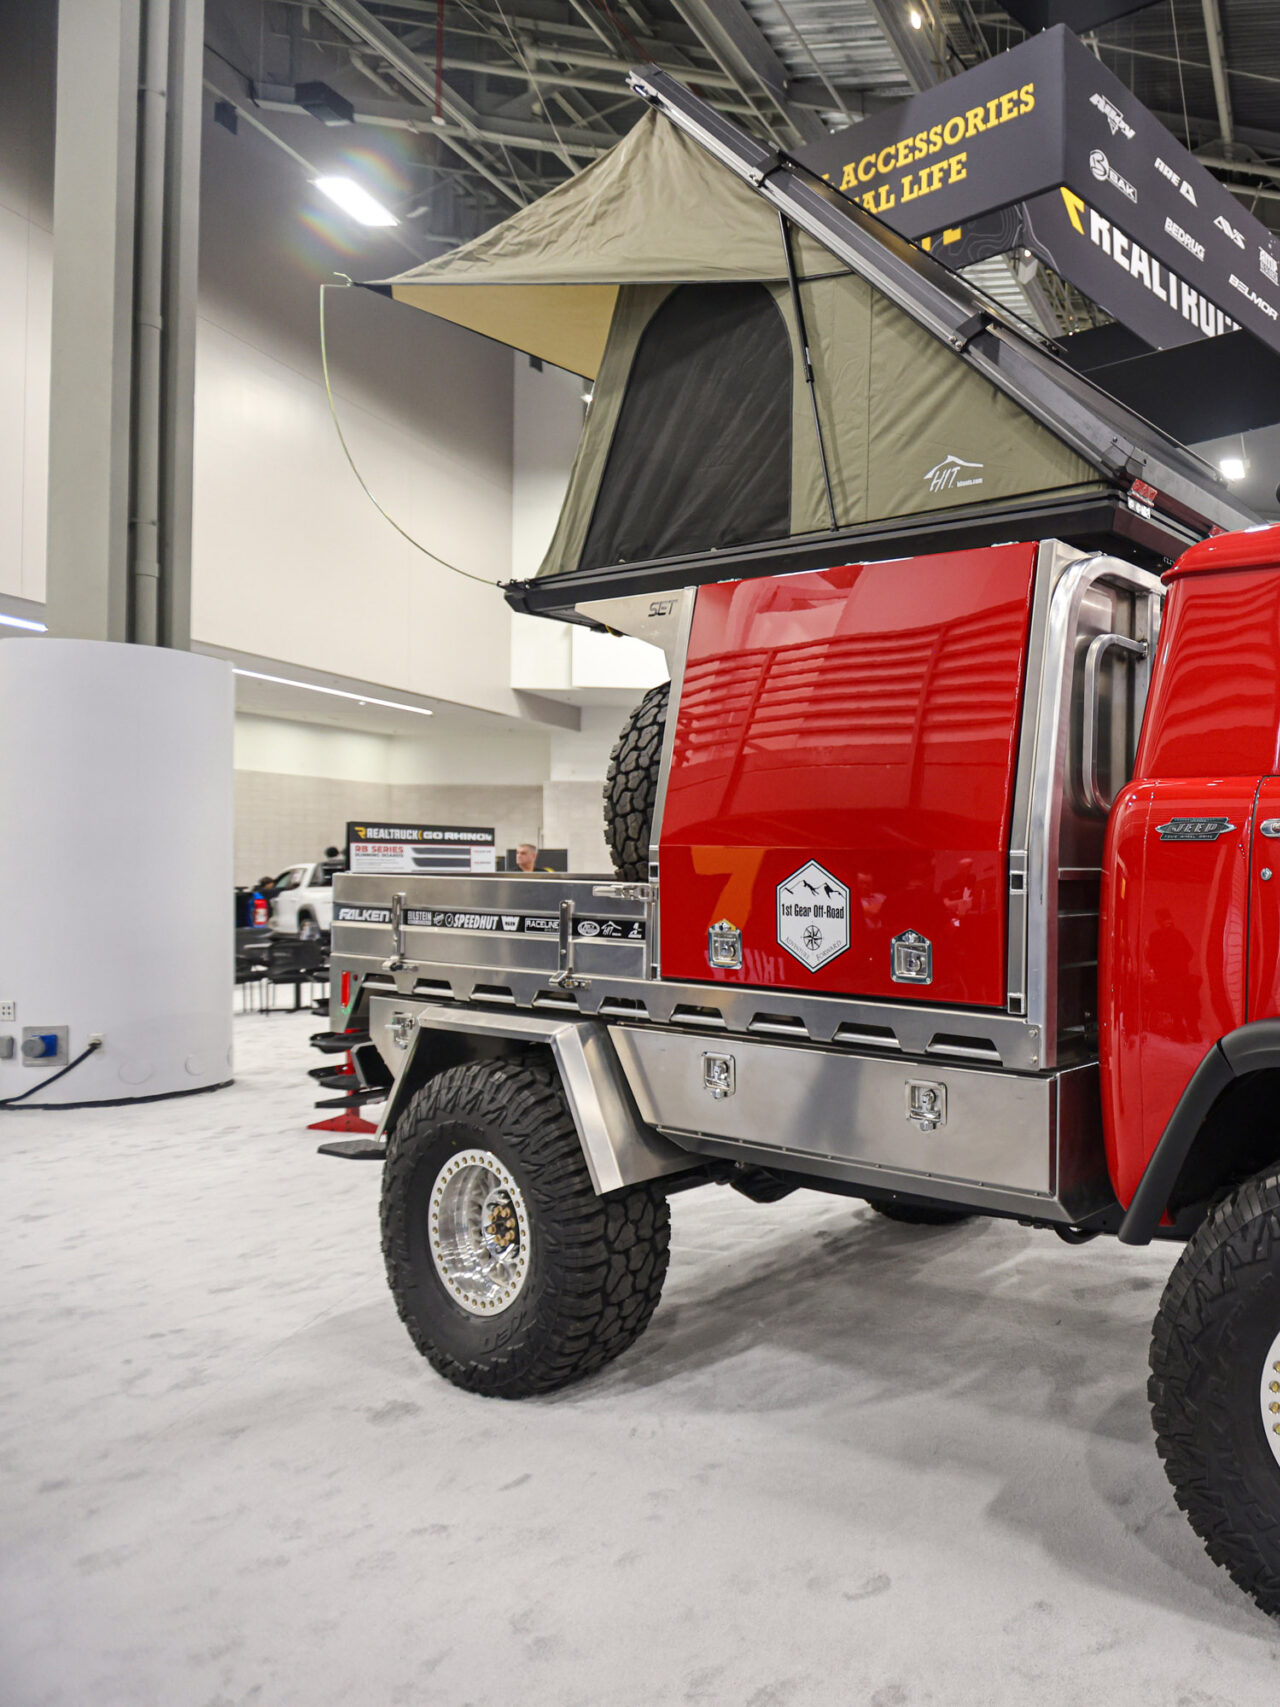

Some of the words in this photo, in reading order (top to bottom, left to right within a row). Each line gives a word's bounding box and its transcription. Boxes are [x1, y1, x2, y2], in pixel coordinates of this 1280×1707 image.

[839, 83, 1036, 191] ACCESSORIES
[852, 184, 896, 214] AL
[901, 151, 968, 203] LIFE
[1164, 216, 1206, 262] BEDRUG
[1090, 208, 1243, 338] REALTRUC
[1228, 273, 1279, 321] BELMOR
[929, 466, 960, 492] HIT
[367, 828, 418, 840] REALTRUCK
[423, 831, 443, 839] GO
[1171, 823, 1217, 833] JEEP
[339, 908, 390, 922] FALKEN
[454, 914, 499, 930] SPEEDHUT
[782, 903, 793, 916] 1st
[795, 904, 811, 917] Gear
[813, 904, 844, 919] Off-Road
